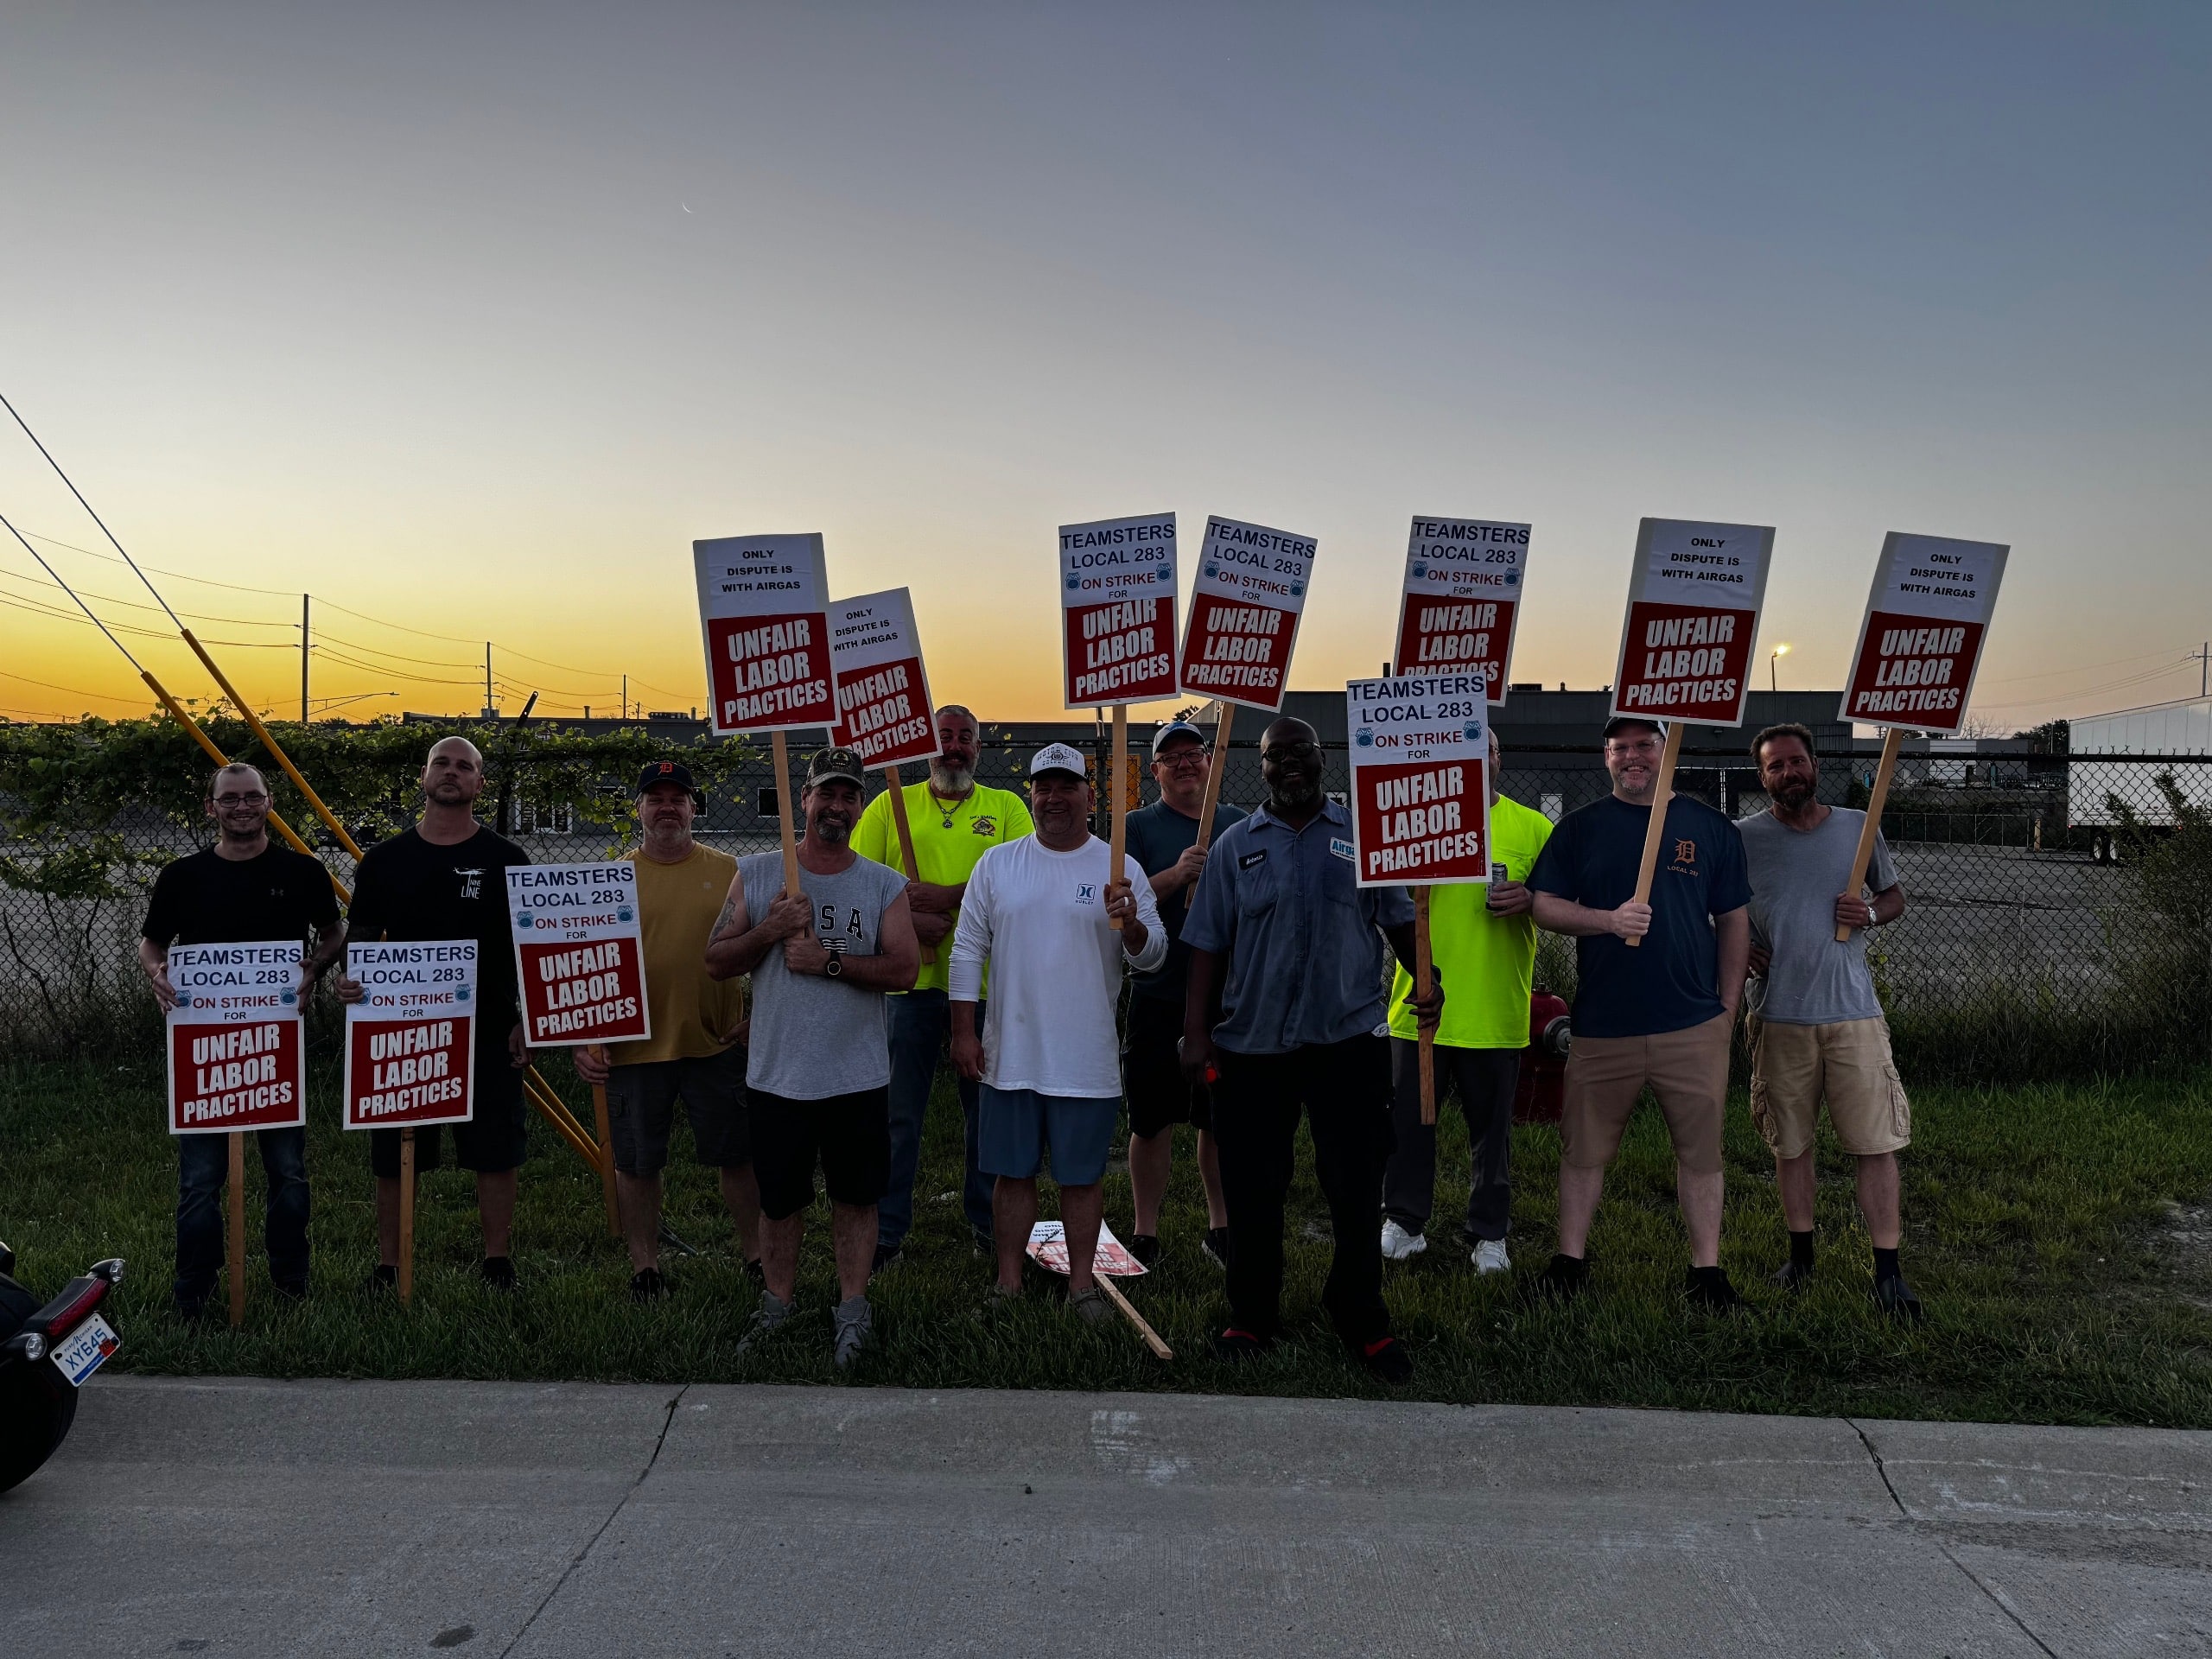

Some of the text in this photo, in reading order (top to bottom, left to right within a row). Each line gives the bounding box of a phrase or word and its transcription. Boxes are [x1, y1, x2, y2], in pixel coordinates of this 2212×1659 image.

[1060, 524, 1175, 550] TEAMSTERS
[1209, 522, 1315, 558] TEAMSTERS
[1414, 522, 1529, 544] TEAMSTERS
[1691, 538, 1725, 549] ONLY
[742, 550, 774, 559] ONLY
[1071, 547, 1165, 569] LOCAL 283
[1213, 545, 1302, 575] LOCAL 283
[1421, 545, 1516, 563] LOCAL 283
[1670, 553, 1739, 566] DISPUTE IS
[1930, 554, 1961, 564] ONLY
[727, 566, 778, 576] DISPUTE
[1082, 573, 1156, 590] ON STRIKE
[1428, 570, 1503, 586] ON STRIKE
[1662, 569, 1744, 583] WITH AIRGAS
[1910, 568, 1974, 582] DISPUTE IS
[721, 581, 800, 593] WITH AIRGAS
[1109, 590, 1128, 599] FOR
[1219, 572, 1288, 595] ON STRIKE
[1453, 586, 1472, 594] FOR
[1900, 583, 1975, 599] WITH AIRGAS
[1243, 590, 1260, 601] FOR
[846, 608, 873, 620] ONLY
[1083, 599, 1157, 639] UNFAIR
[1207, 607, 1281, 635] UNFAIR
[1420, 604, 1497, 632] UNFAIR
[728, 620, 810, 662] UNFAIR
[836, 622, 877, 637] DISPUTE
[1646, 615, 1736, 648] UNFAIR
[834, 632, 898, 652] WITH AIRGAS
[1087, 627, 1154, 669] LABOR
[1204, 636, 1272, 663] LABOR
[1419, 633, 1489, 662] LABOR
[1880, 627, 1965, 657] UNFAIR
[735, 652, 810, 693] LABOR
[1076, 653, 1170, 697] PRACTICES
[1643, 648, 1726, 679] LABOR
[1875, 658, 1954, 687] LABOR
[1186, 664, 1279, 688] PRACTICES
[839, 665, 908, 711] UNFAIR
[1349, 677, 1484, 701] TEAMSTERS
[1625, 679, 1737, 707] PRACTICES
[725, 680, 828, 724] PRACTICES
[1855, 688, 1960, 713] PRACTICES
[848, 694, 911, 738] LABOR
[1362, 702, 1473, 723] LOCAL 283
[1375, 731, 1462, 747] ON STRIKE
[1408, 750, 1429, 759] FOR
[1376, 766, 1464, 811] UNFAIR
[1382, 801, 1461, 844] LABOR
[1370, 831, 1478, 875] PRACTICES
[508, 868, 634, 887] TEAMSTERS
[521, 889, 625, 908] LOCAL 283
[535, 914, 616, 929] ON STRIKE
[566, 931, 587, 939] FOR
[170, 946, 302, 966] TEAMSTERS
[349, 944, 476, 964] TEAMSTERS
[539, 943, 621, 982] UNFAIR
[181, 969, 290, 986] LOCAL 283
[360, 967, 465, 984] LOCAL 283
[193, 994, 280, 1008] ON STRIKE
[372, 993, 454, 1007] ON STRIKE
[545, 972, 620, 1010] LABOR
[224, 1012, 247, 1020] FOR
[537, 996, 638, 1037] PRACTICES
[193, 1024, 281, 1065] UNFAIR
[370, 1020, 454, 1061] UNFAIR
[196, 1056, 277, 1096] LABOR
[373, 1052, 449, 1091] LABOR
[183, 1082, 293, 1123] PRACTICES
[359, 1077, 462, 1119] PRACTICES
[1049, 1262, 1130, 1271] PRTICES
[65, 1328, 107, 1370] XY645
